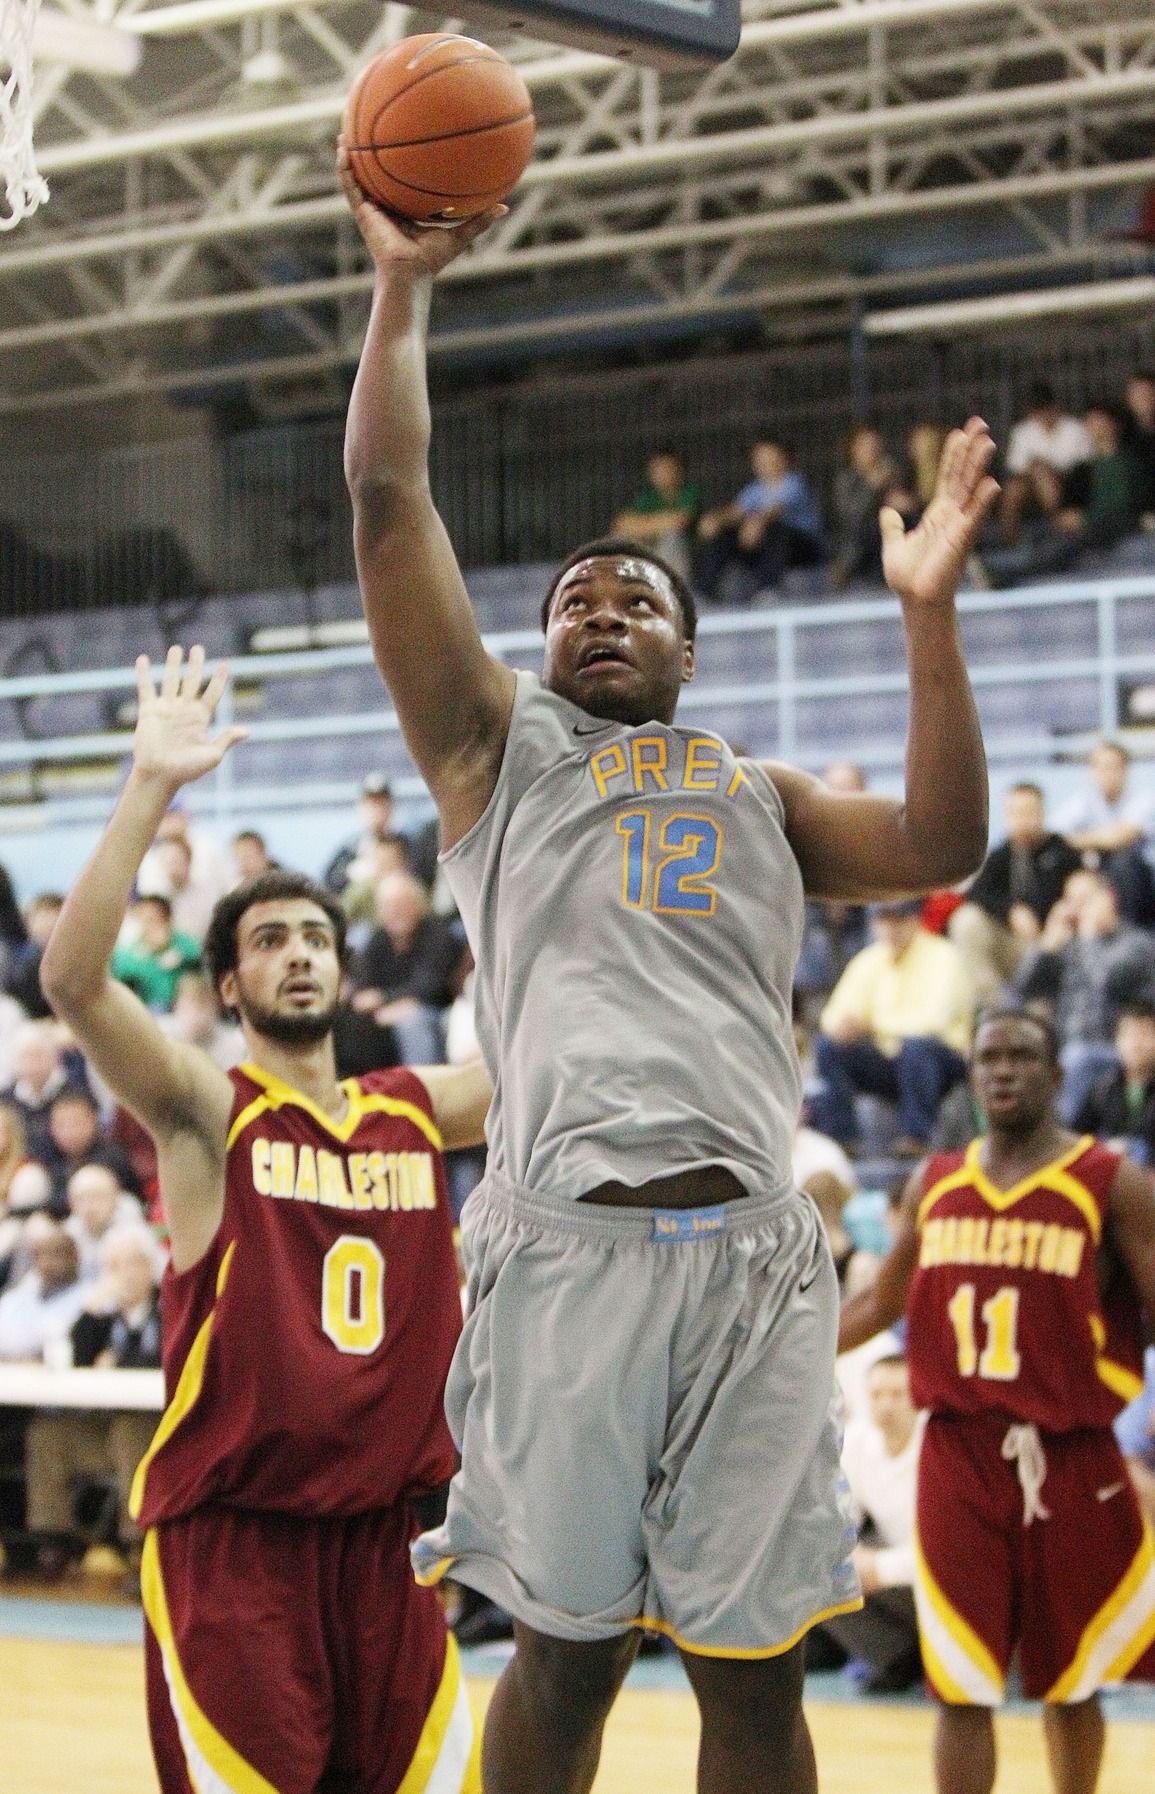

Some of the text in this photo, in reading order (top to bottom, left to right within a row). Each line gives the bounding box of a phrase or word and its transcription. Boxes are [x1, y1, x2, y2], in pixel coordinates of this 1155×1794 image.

[615, 809, 723, 916] 12
[321, 1234, 385, 1356] 0
[948, 1282, 1021, 1381] 11
